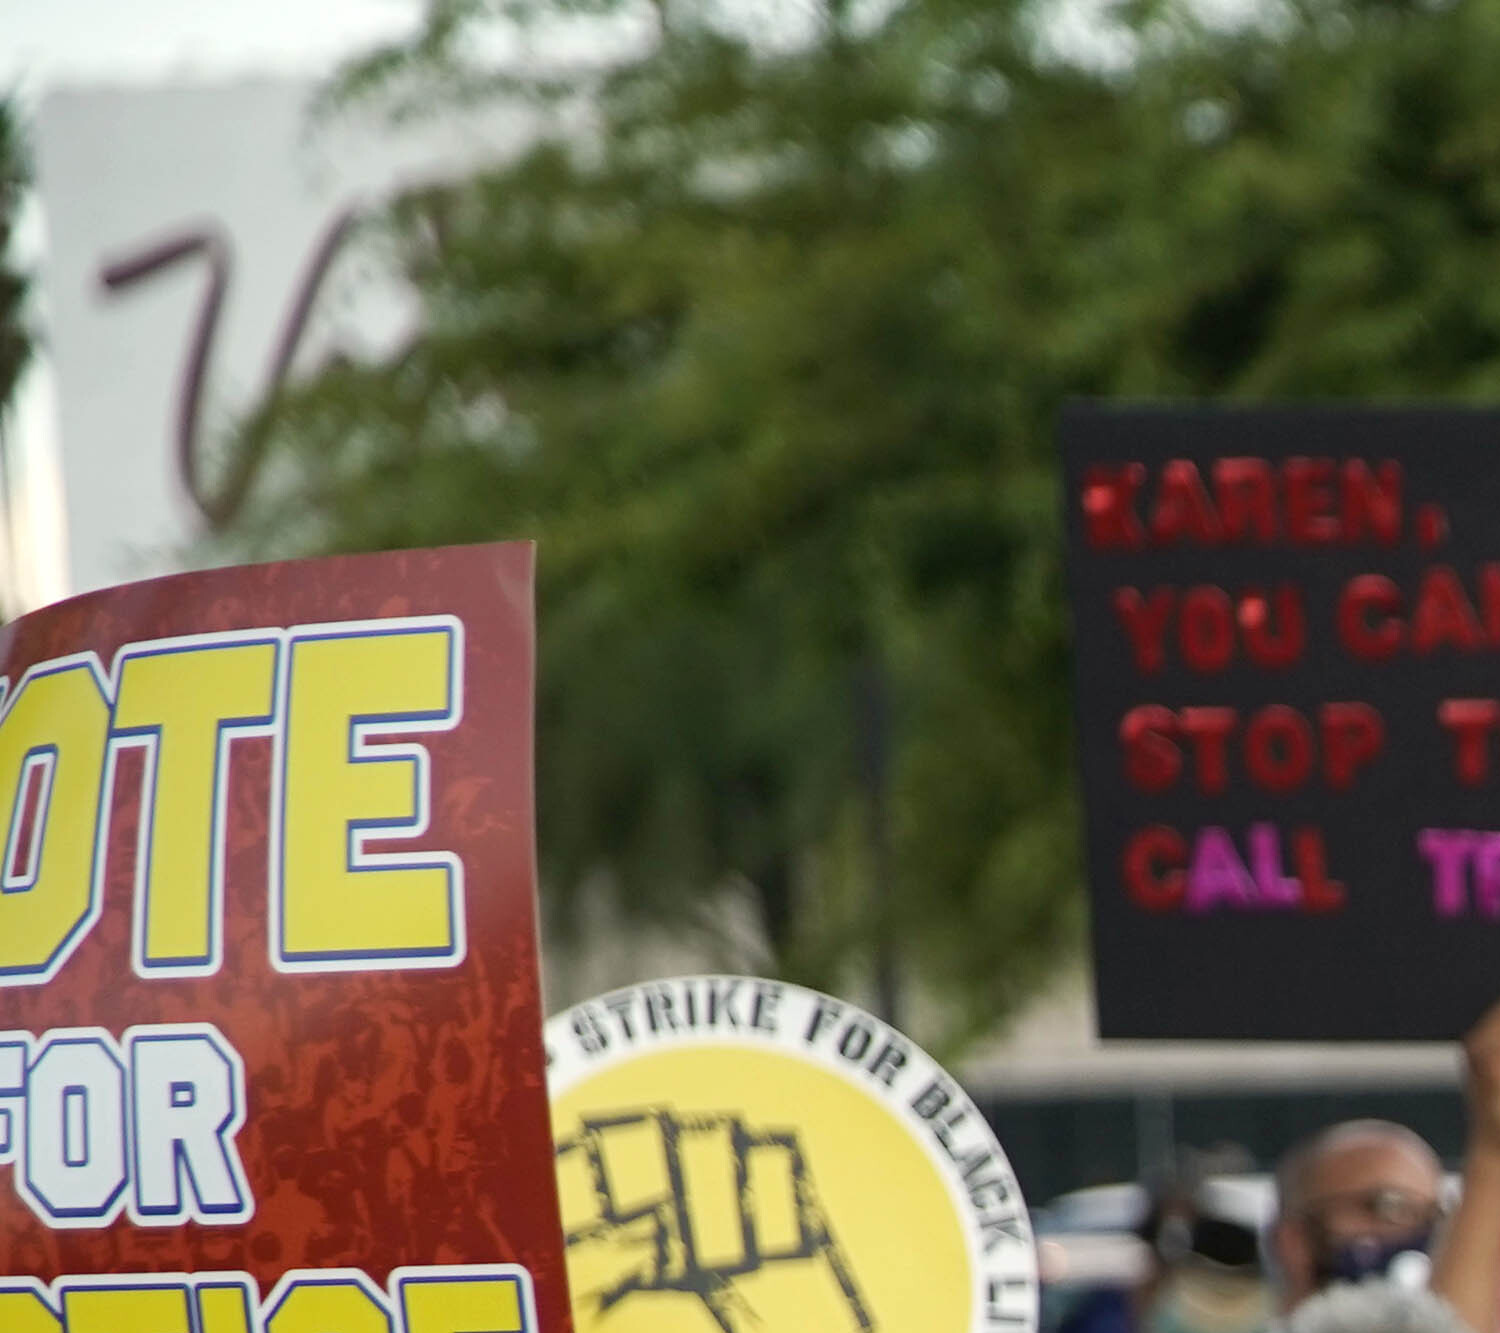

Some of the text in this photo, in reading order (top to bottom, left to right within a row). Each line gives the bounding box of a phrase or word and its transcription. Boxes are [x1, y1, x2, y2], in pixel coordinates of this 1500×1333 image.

[1082, 456, 1447, 550] KAREN,
[1113, 585, 1306, 674] YOU
[1119, 700, 1385, 793] STOP
[0, 613, 467, 987] OTE
[1122, 823, 1347, 914] CALL
[572, 979, 780, 1055] STRIKE
[803, 995, 907, 1088] FOR
[911, 1076, 1028, 1251] BLACK
